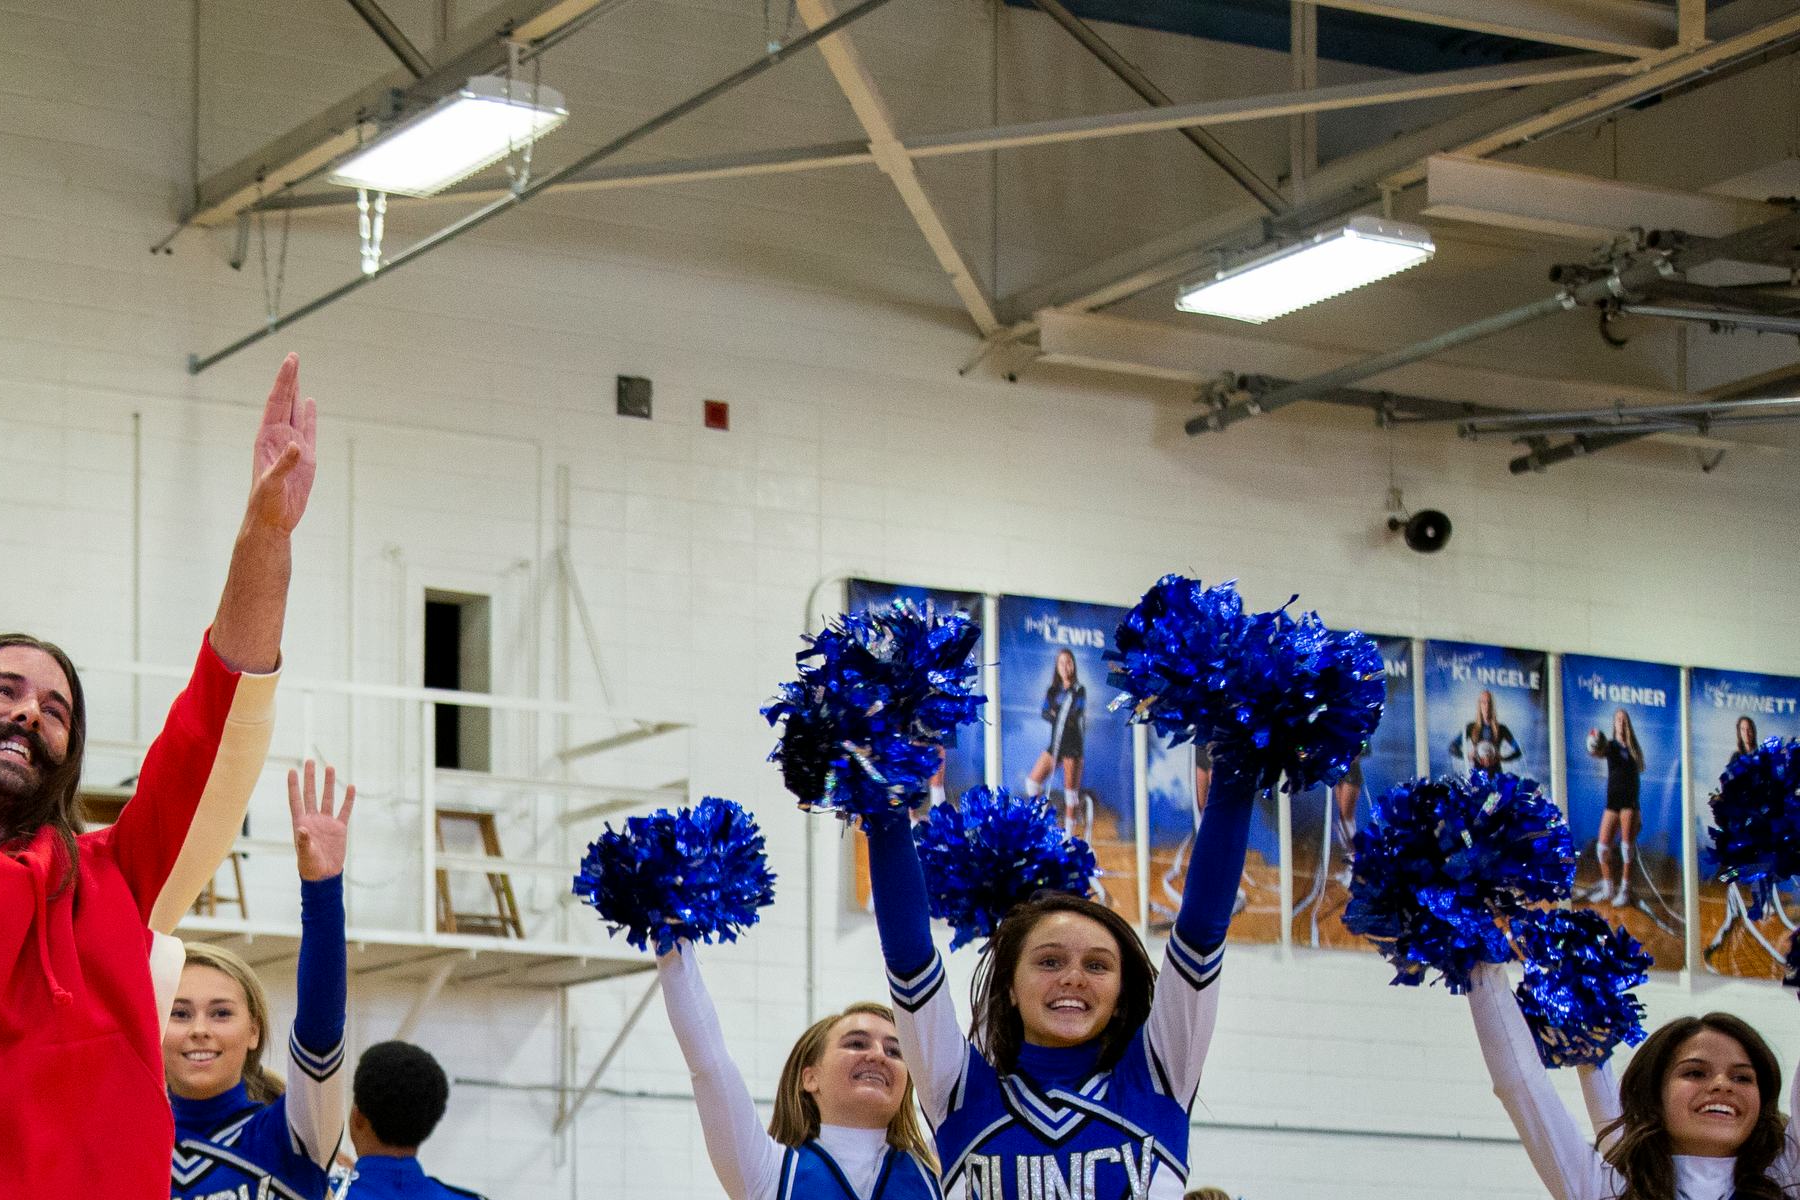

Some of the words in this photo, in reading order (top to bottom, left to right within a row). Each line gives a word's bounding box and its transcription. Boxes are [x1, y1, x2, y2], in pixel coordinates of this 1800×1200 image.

[1043, 624, 1104, 648] LEWIS
[1452, 664, 1540, 690] KLINGELE
[1592, 684, 1667, 707] HOENER
[1713, 691, 1796, 714] STINNETT
